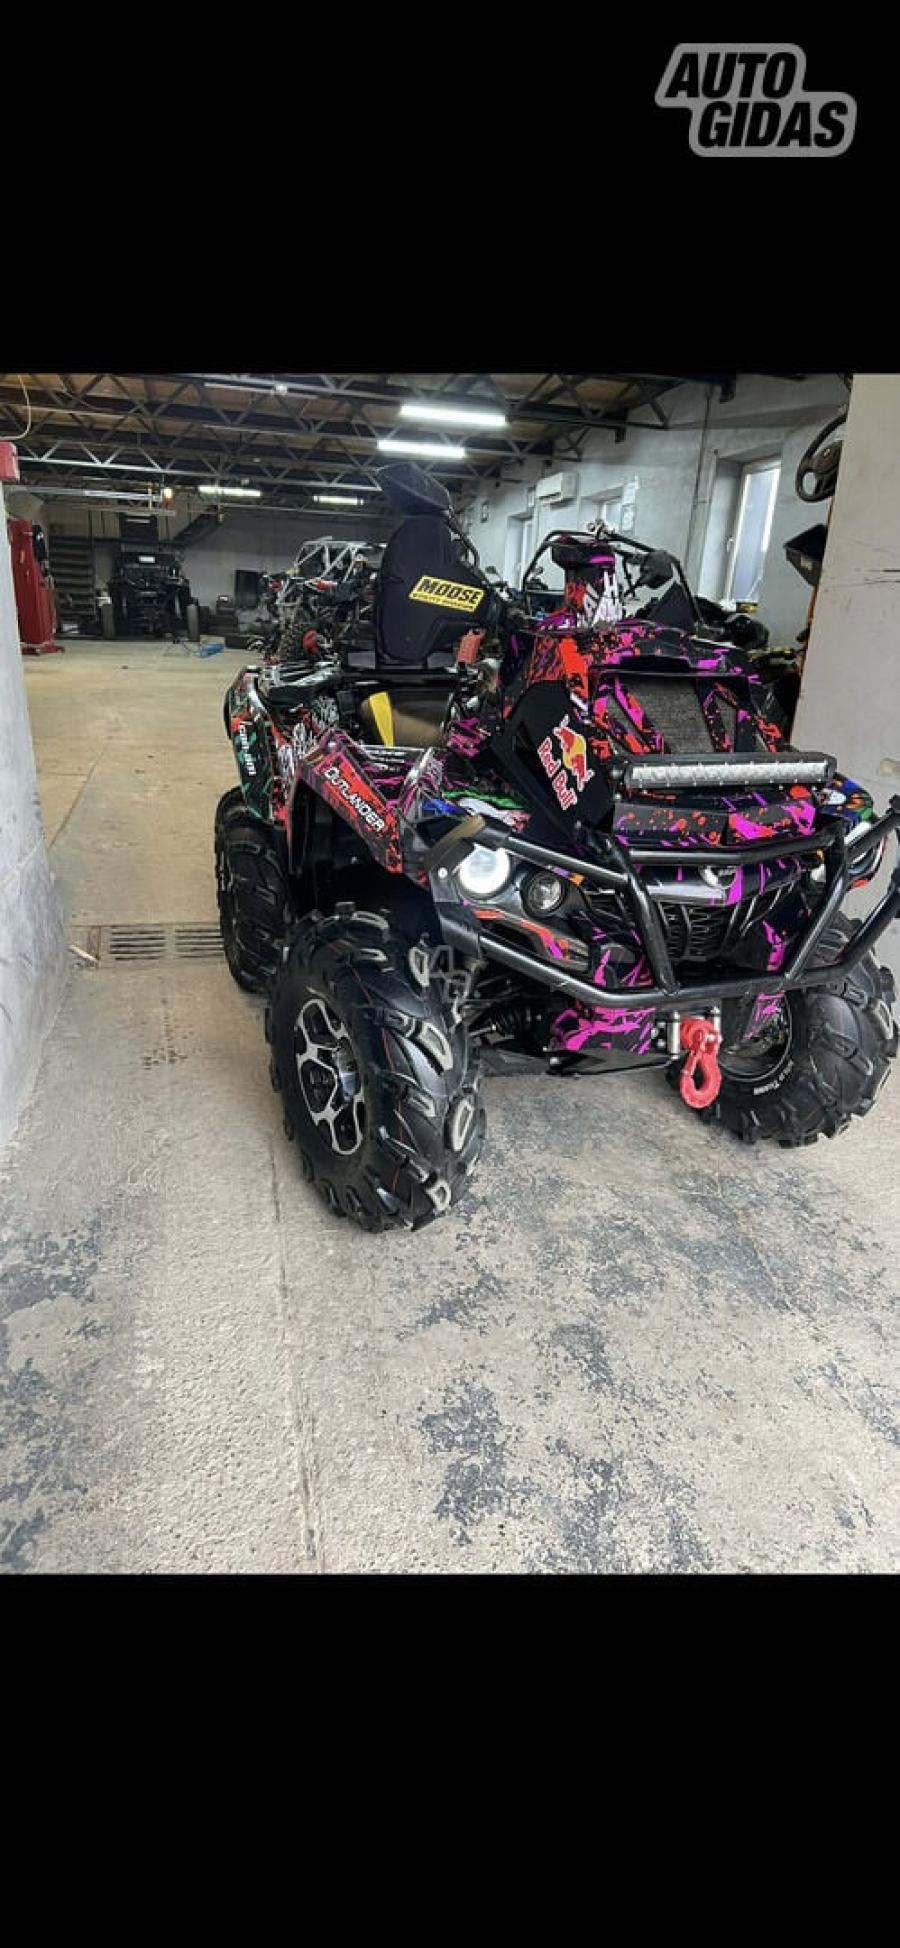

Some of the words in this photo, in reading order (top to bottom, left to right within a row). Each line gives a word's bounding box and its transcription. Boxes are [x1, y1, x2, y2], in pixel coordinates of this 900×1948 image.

[418, 579, 481, 604] MOOSE
[324, 766, 385, 832] OUTLANDER
[538, 737, 561, 778] Red
[552, 769, 578, 810] Bull
